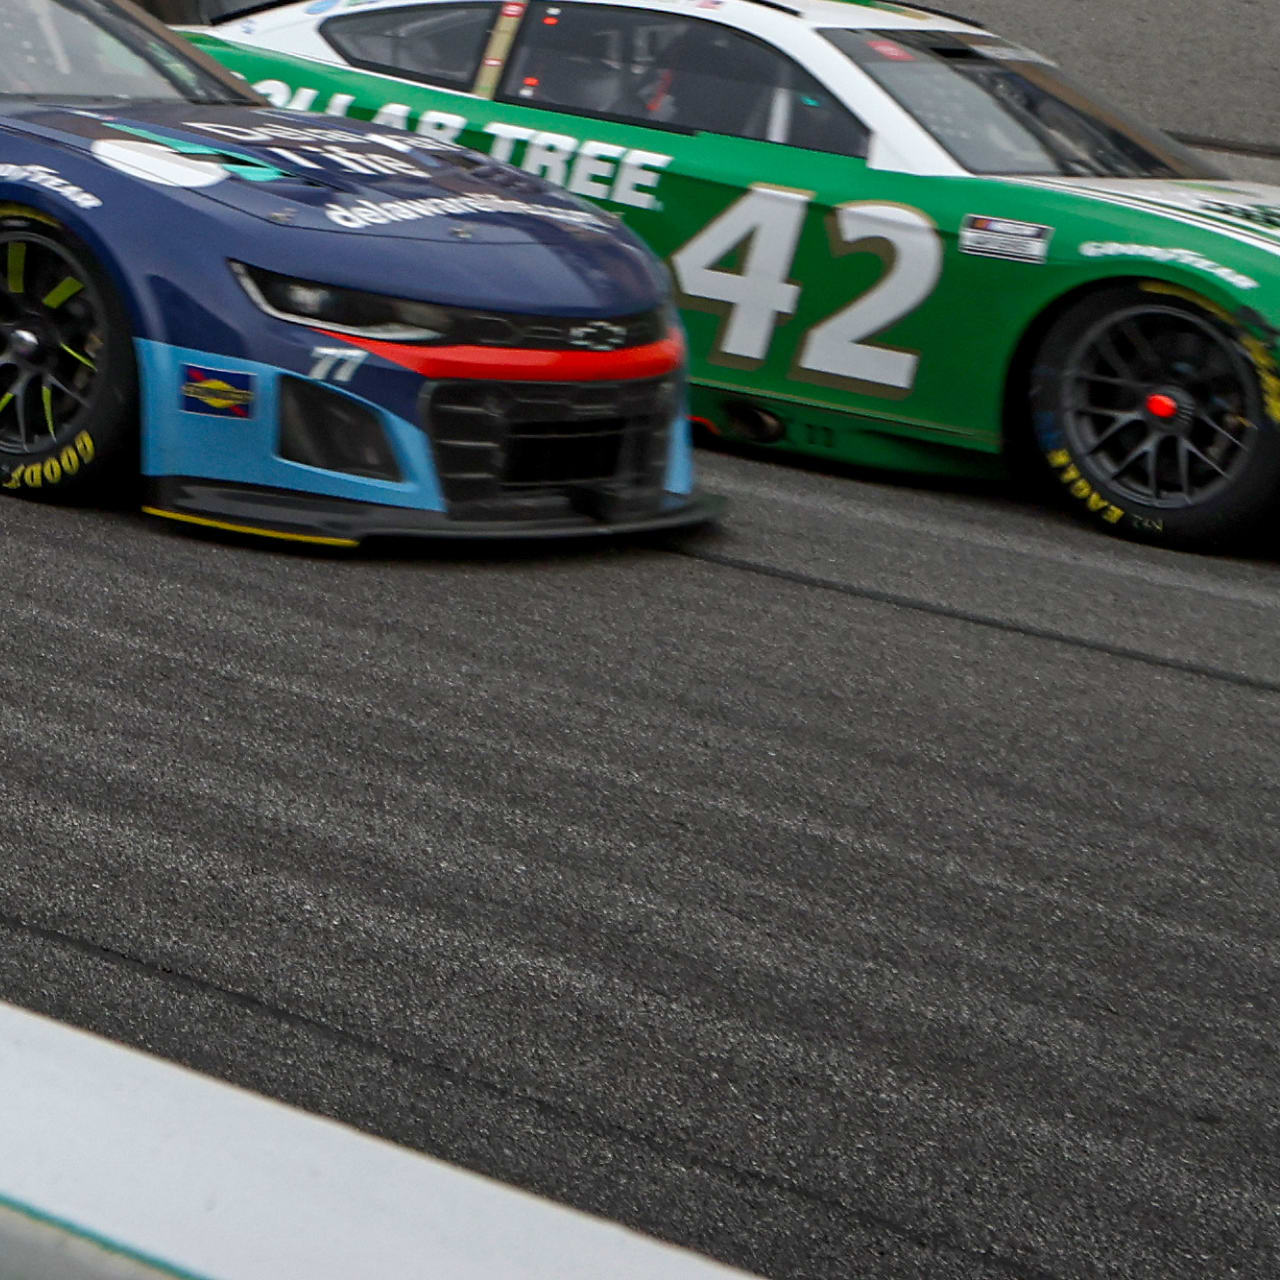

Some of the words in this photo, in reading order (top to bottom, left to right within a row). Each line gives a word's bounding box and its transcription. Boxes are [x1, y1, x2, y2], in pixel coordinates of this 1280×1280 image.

[484, 121, 675, 211] TREE
[668, 180, 946, 400] 42
[309, 346, 371, 383] 77
